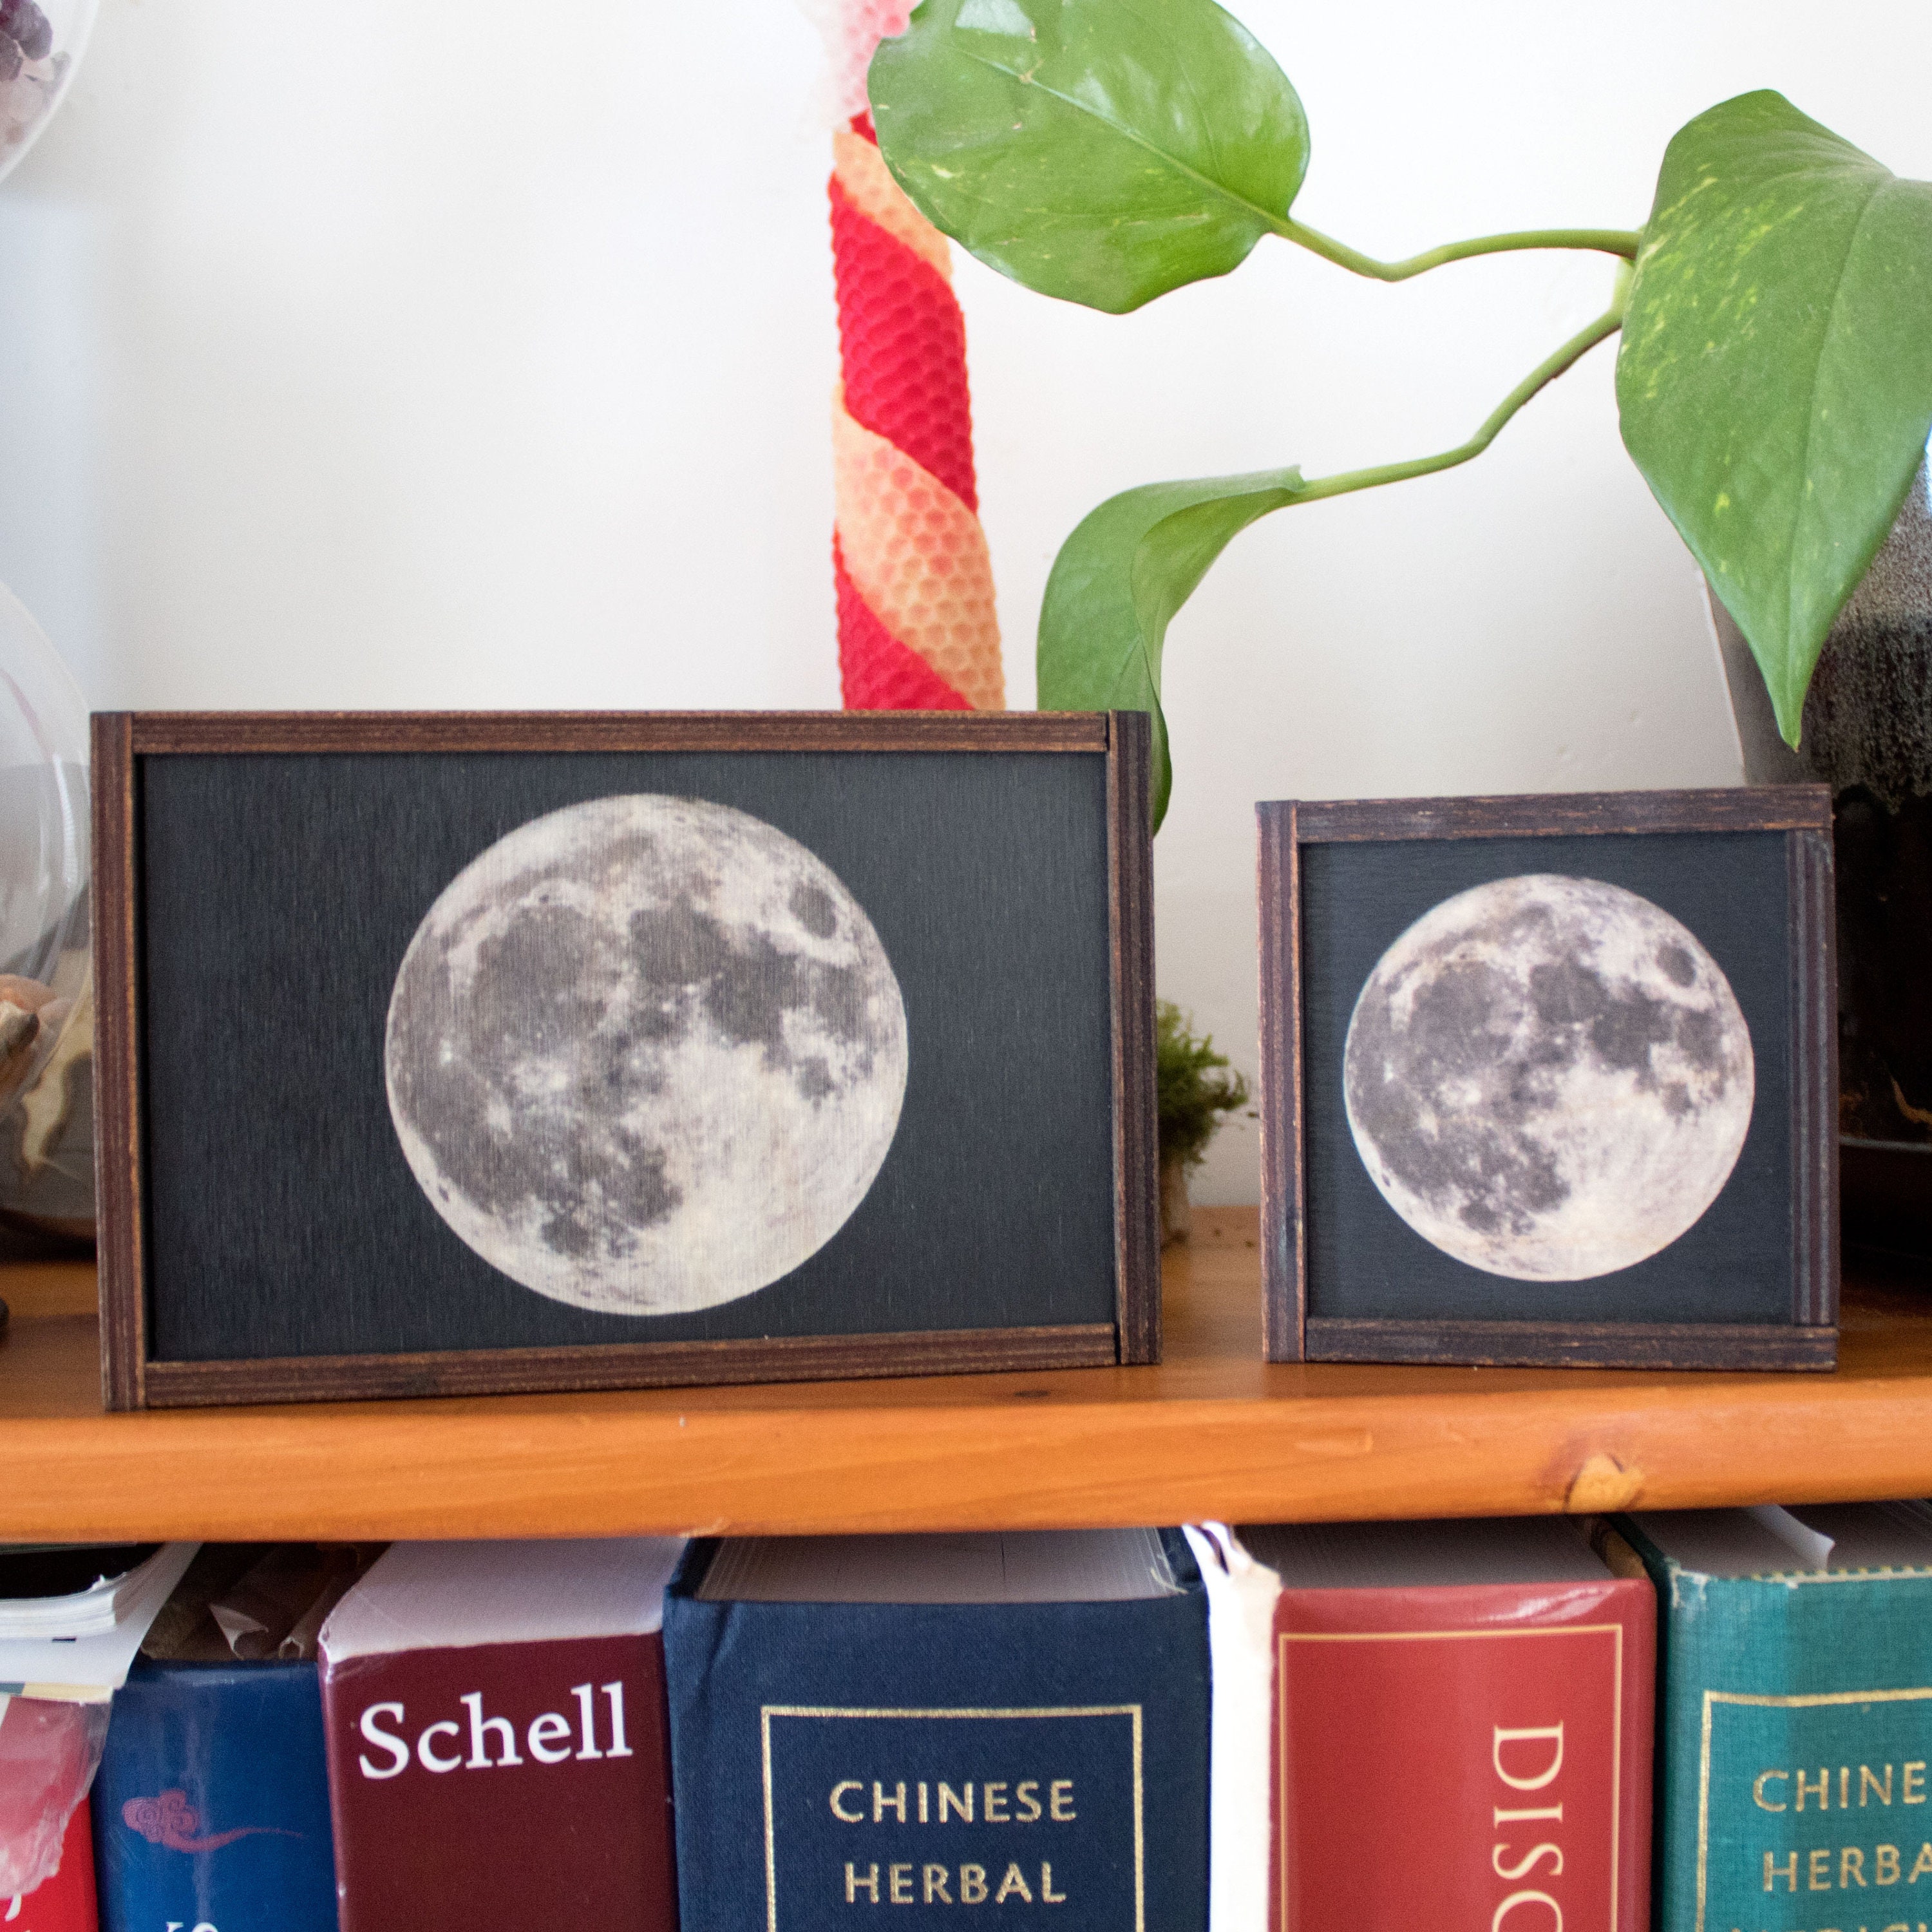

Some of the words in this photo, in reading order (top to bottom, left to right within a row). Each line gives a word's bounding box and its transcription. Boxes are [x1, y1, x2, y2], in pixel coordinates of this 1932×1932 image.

[359, 1681, 633, 1779] Schell
[829, 1779, 1077, 1824] CHINESE
[1752, 1760, 1927, 1812] CHINE
[844, 1861, 1066, 1904] HERBAL
